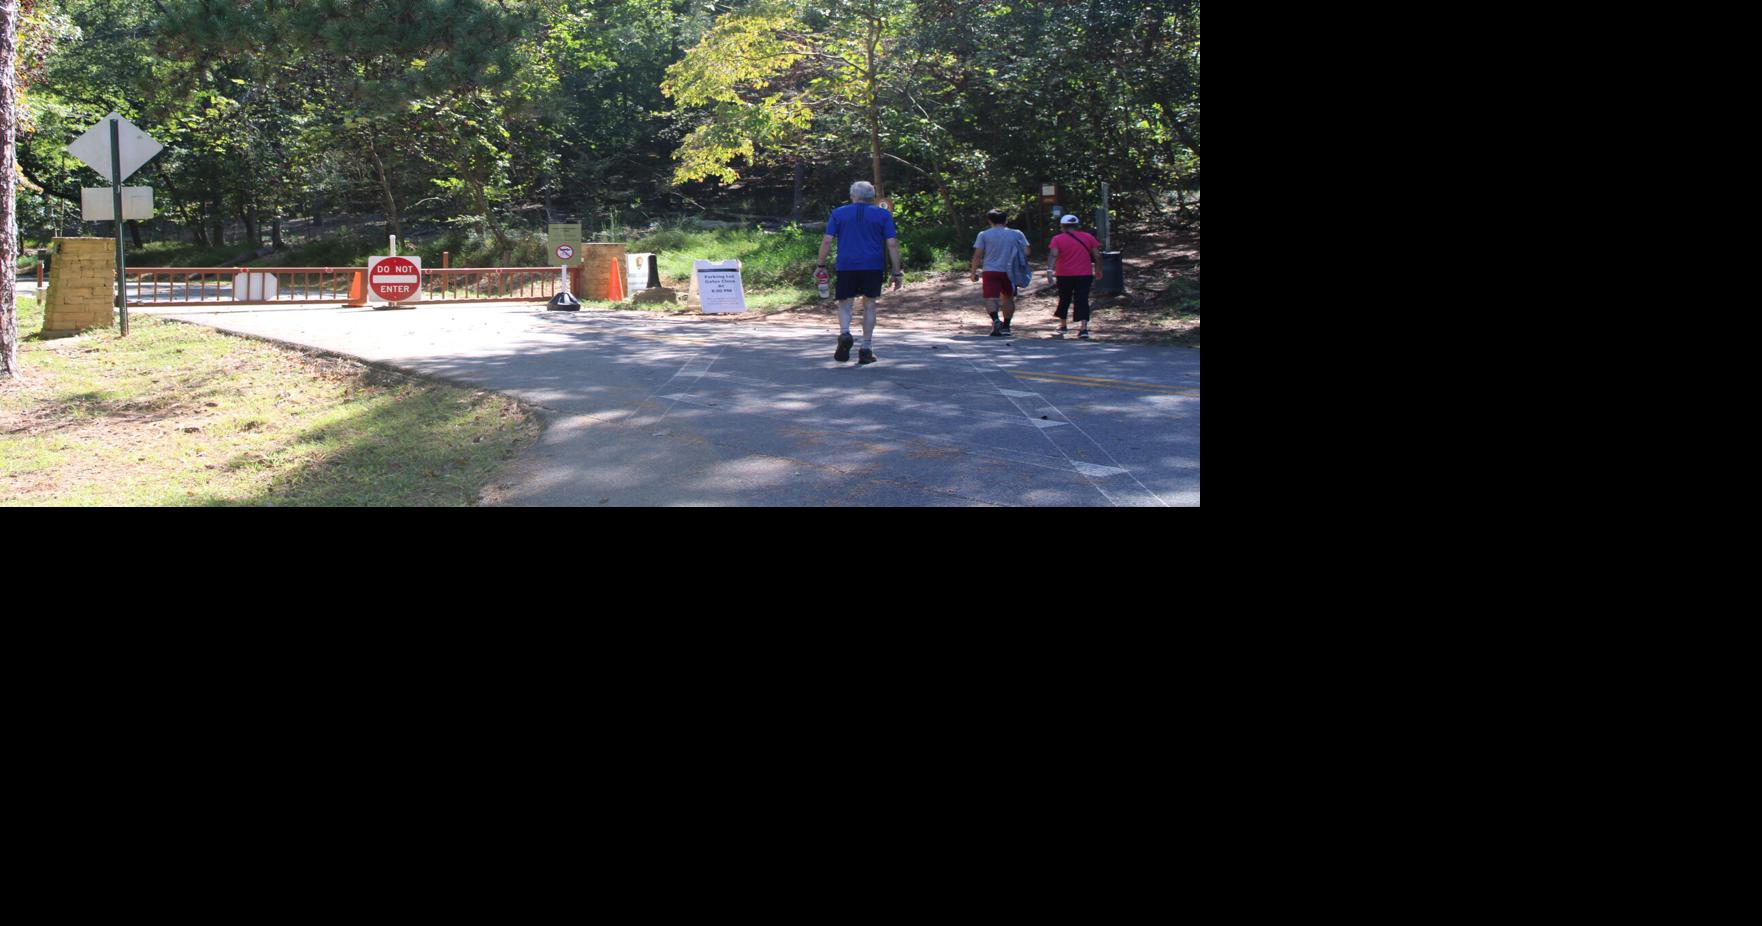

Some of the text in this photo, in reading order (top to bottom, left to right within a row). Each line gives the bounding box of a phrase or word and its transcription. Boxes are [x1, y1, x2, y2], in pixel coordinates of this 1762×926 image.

[377, 265, 413, 273] DO NOT
[380, 285, 410, 293] ENTER
